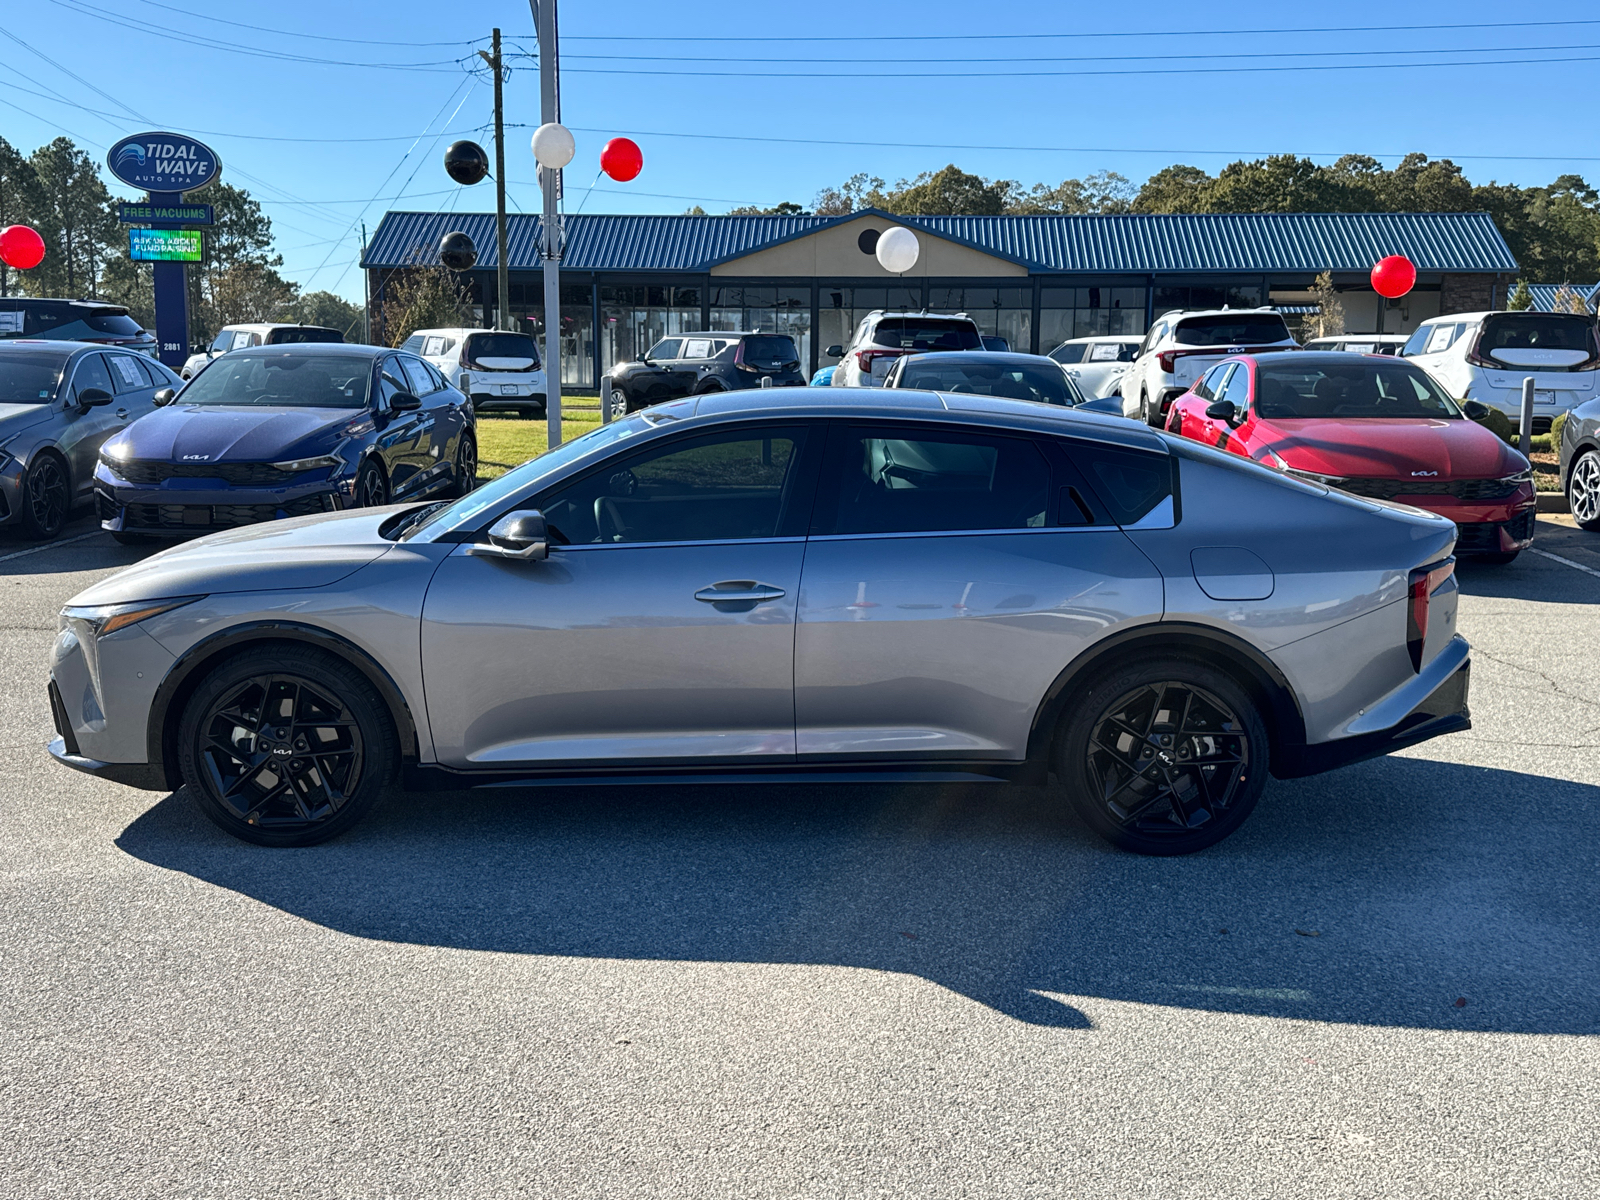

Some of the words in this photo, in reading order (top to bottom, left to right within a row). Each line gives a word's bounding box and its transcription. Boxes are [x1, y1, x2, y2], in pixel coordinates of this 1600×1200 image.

[147, 143, 197, 159] TIDAL
[155, 159, 208, 175] WAVE
[124, 207, 151, 217] FREE
[154, 208, 206, 218] VACUUMS
[135, 244, 197, 252] FUNDRAISING
